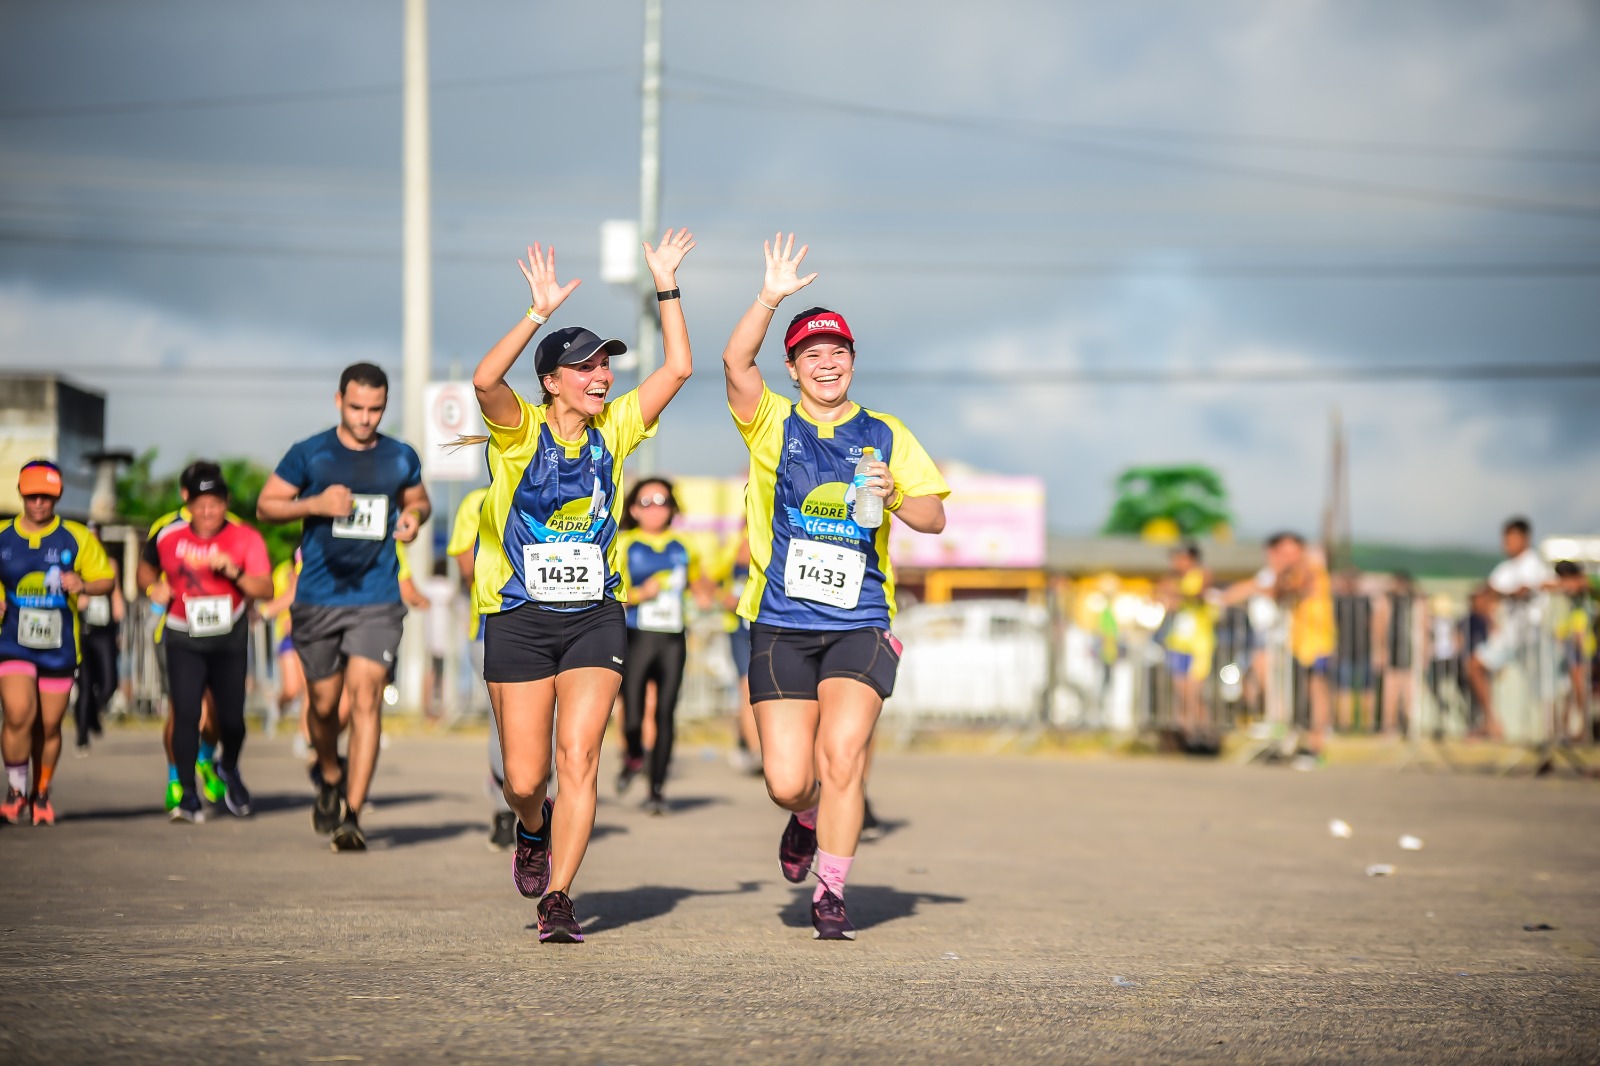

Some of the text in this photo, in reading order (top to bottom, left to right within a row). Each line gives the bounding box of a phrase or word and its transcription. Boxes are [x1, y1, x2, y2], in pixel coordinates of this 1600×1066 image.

[804, 505, 845, 518] PADRE
[549, 519, 589, 531] PADRE
[805, 519, 855, 536] CÍCERO
[537, 566, 589, 583] 1432
[798, 564, 846, 589] 1433
